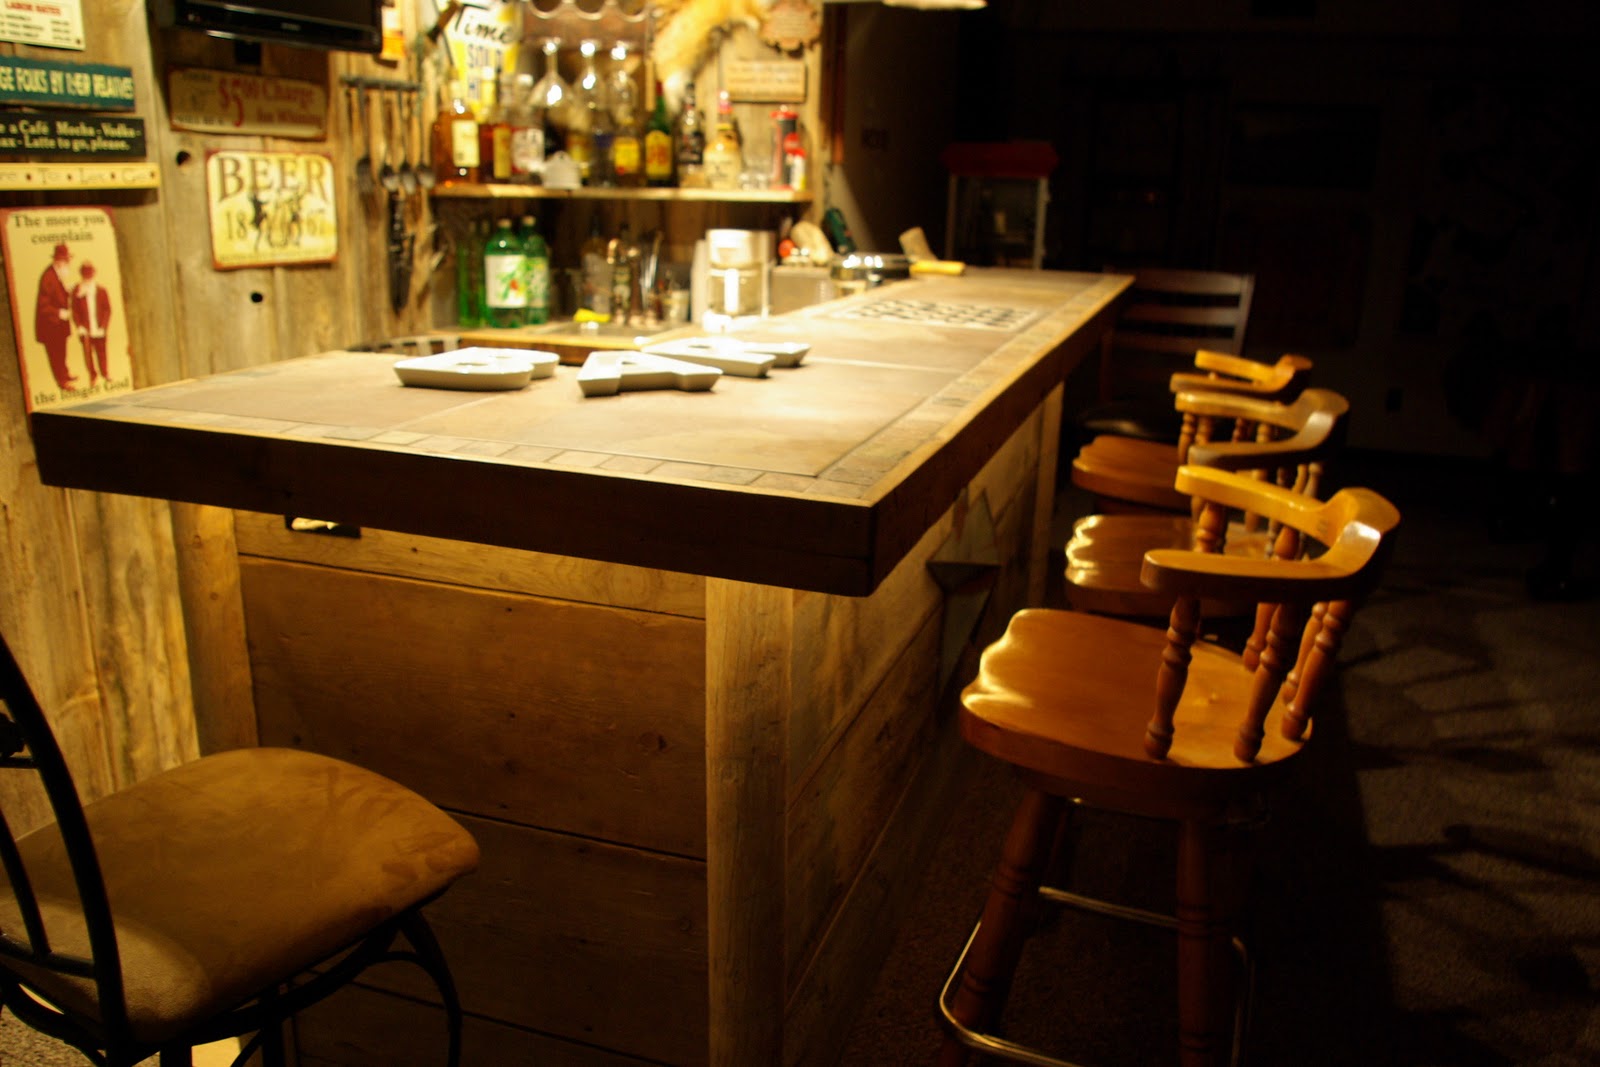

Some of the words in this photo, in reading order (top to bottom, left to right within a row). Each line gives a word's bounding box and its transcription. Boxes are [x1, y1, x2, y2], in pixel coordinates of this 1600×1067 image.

[15, 67, 48, 93] FOLKS
[92, 74, 134, 100] RELATIVES
[24, 135, 56, 149] Latte
[56, 136, 71, 149] to
[217, 156, 329, 203] BEER
[11, 214, 40, 228] The
[45, 215, 79, 225] more
[84, 214, 105, 226] you
[225, 210, 248, 241] 18
[31, 229, 93, 244] complain
[34, 391, 56, 405] the
